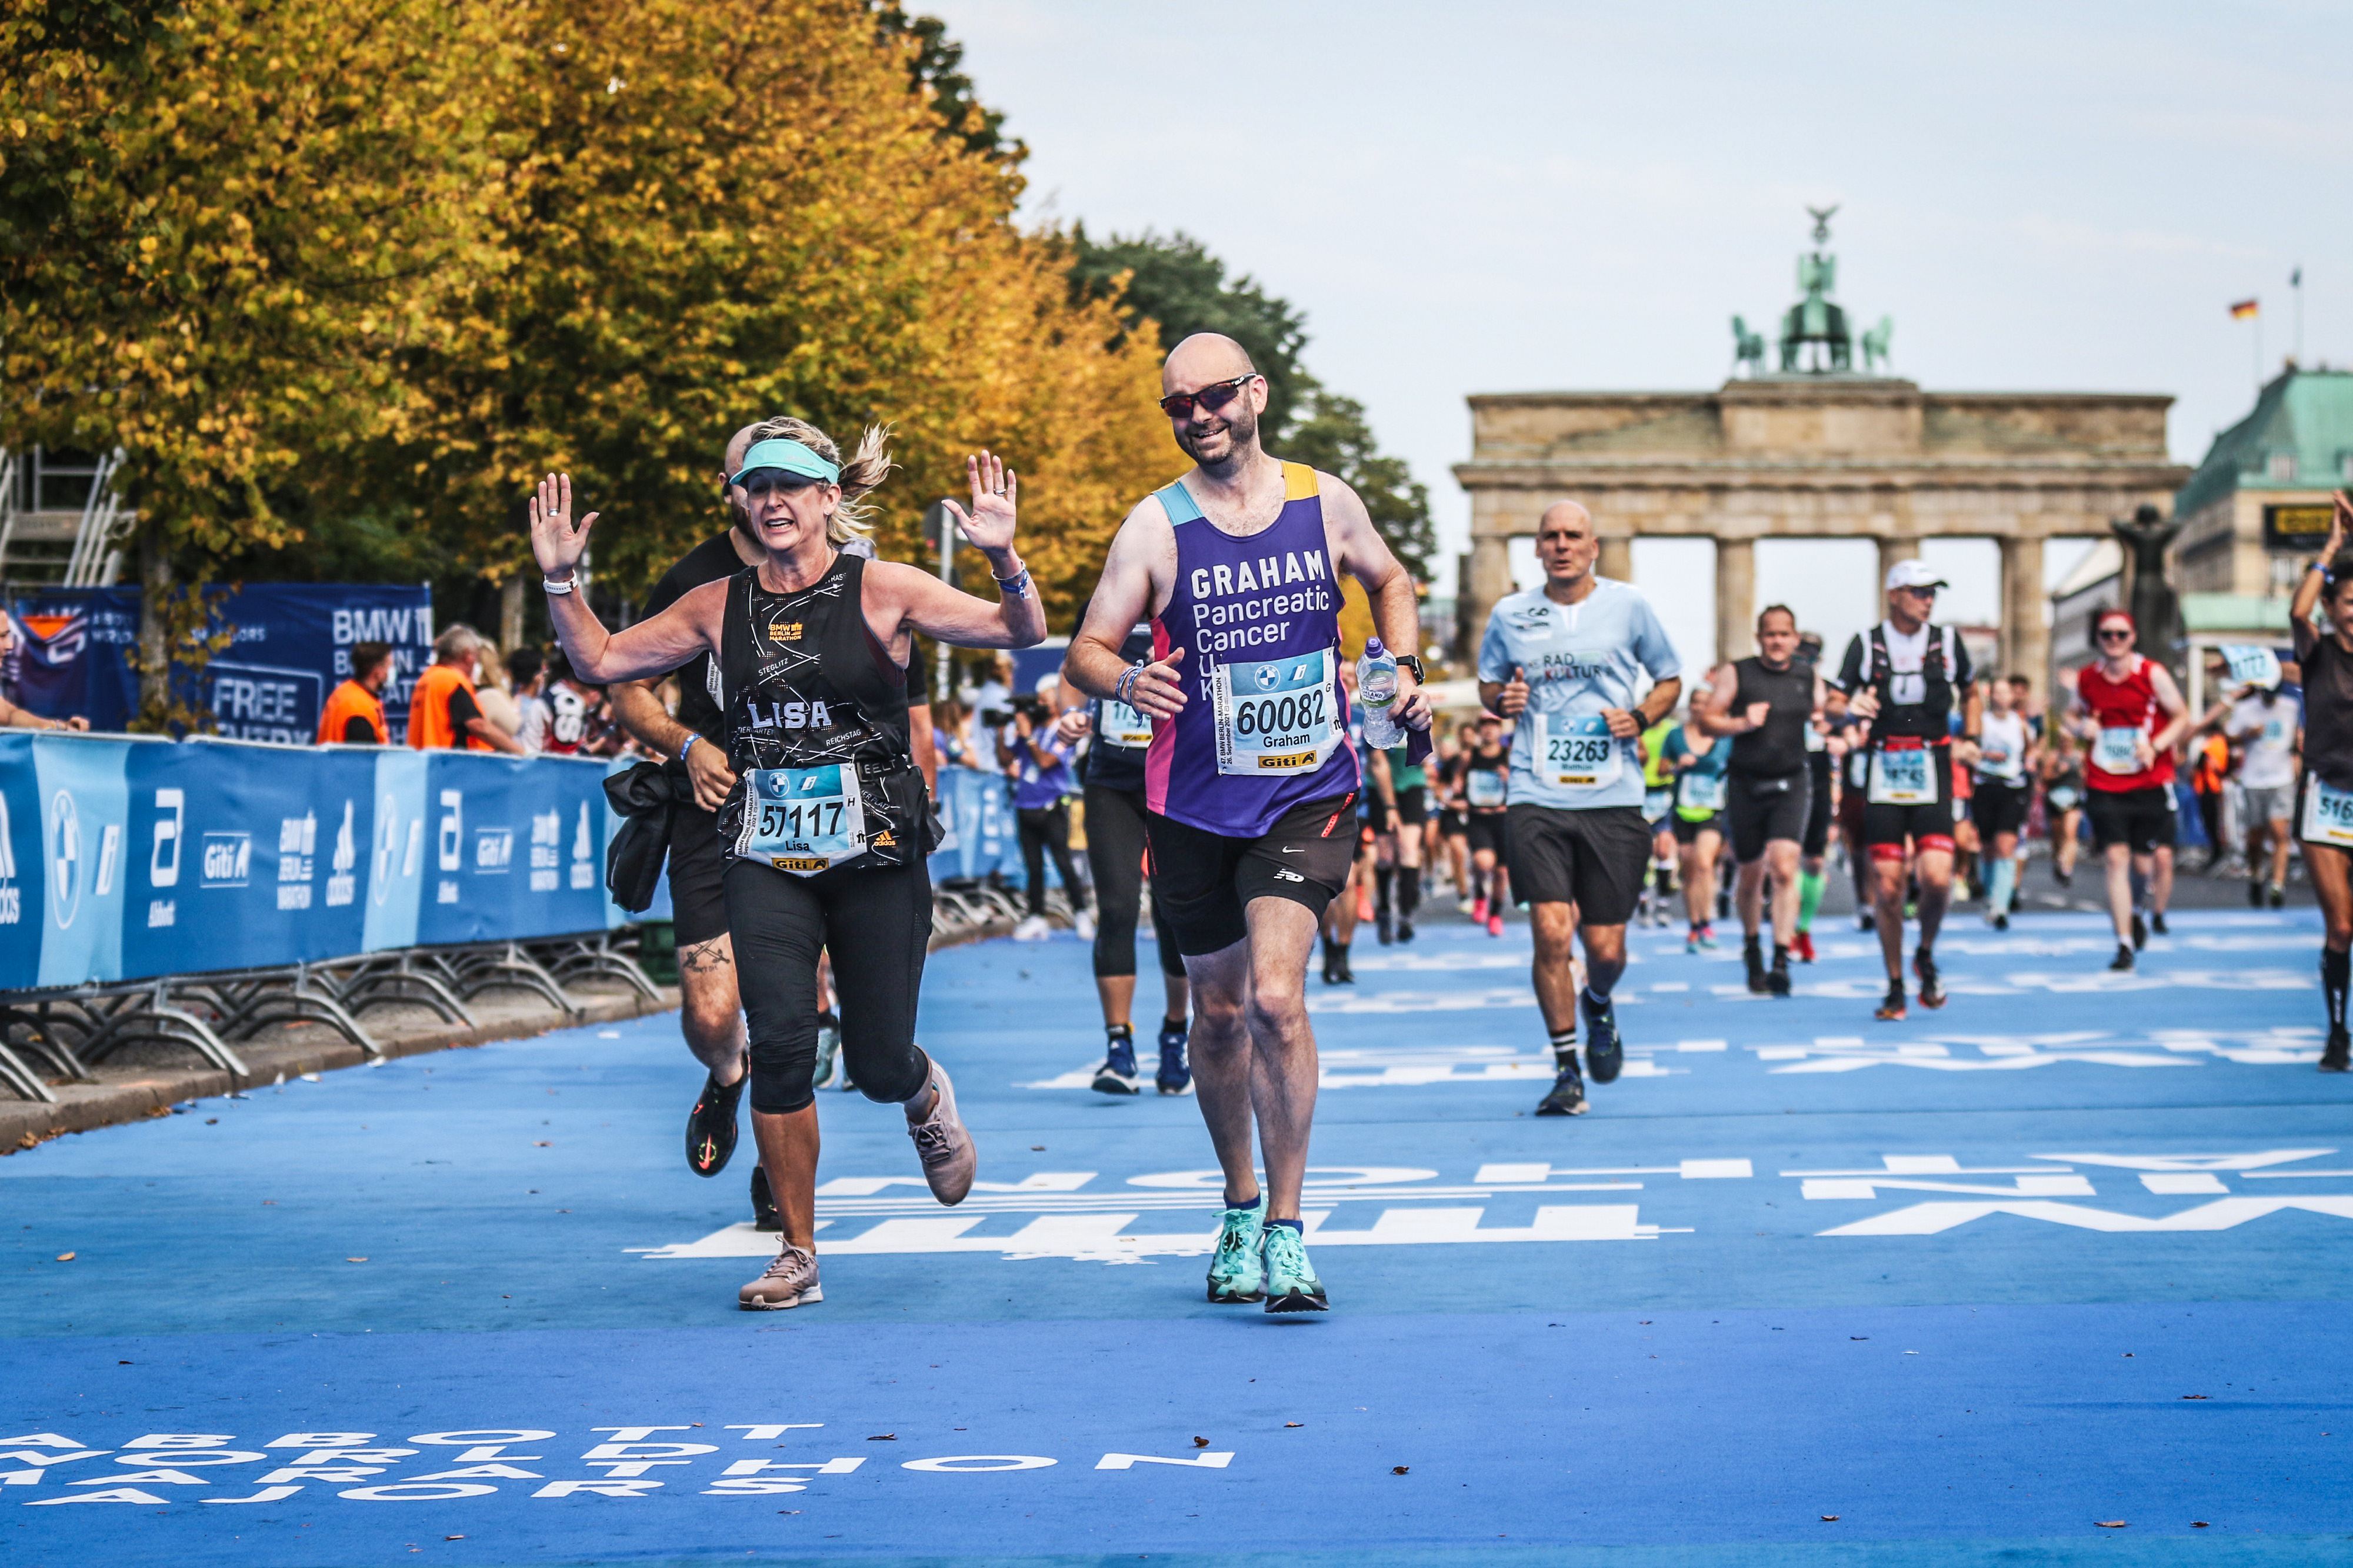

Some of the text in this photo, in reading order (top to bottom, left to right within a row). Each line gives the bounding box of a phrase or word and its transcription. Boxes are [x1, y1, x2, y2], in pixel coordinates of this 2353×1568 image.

[1191, 550, 1325, 599] GRAHAM
[1193, 585, 1329, 628] Pancreatic
[333, 609, 410, 644] BMW
[1197, 621, 1290, 653] Cancer
[758, 658, 788, 676] STEGLITZ
[1544, 653, 1574, 667] RAD
[213, 678, 297, 723] FREE
[1326, 683, 1331, 693] G
[747, 701, 832, 729] LISA
[1216, 678, 1225, 740] BERLIN-MARATHON
[1237, 689, 1325, 735] 60082
[826, 729, 862, 747] REICHSTAG
[1263, 733, 1310, 748] Graham
[1548, 739, 1609, 762] 23263
[1262, 757, 1296, 767] Giti
[743, 781, 753, 840] BERLIN-MARATHON
[848, 797, 855, 807] H
[759, 802, 844, 838] 57117
[744, 829, 755, 856] September
[786, 840, 809, 851] Lisa
[776, 860, 807, 869] Giti
[0, 1423, 824, 1449] ABBOTT
